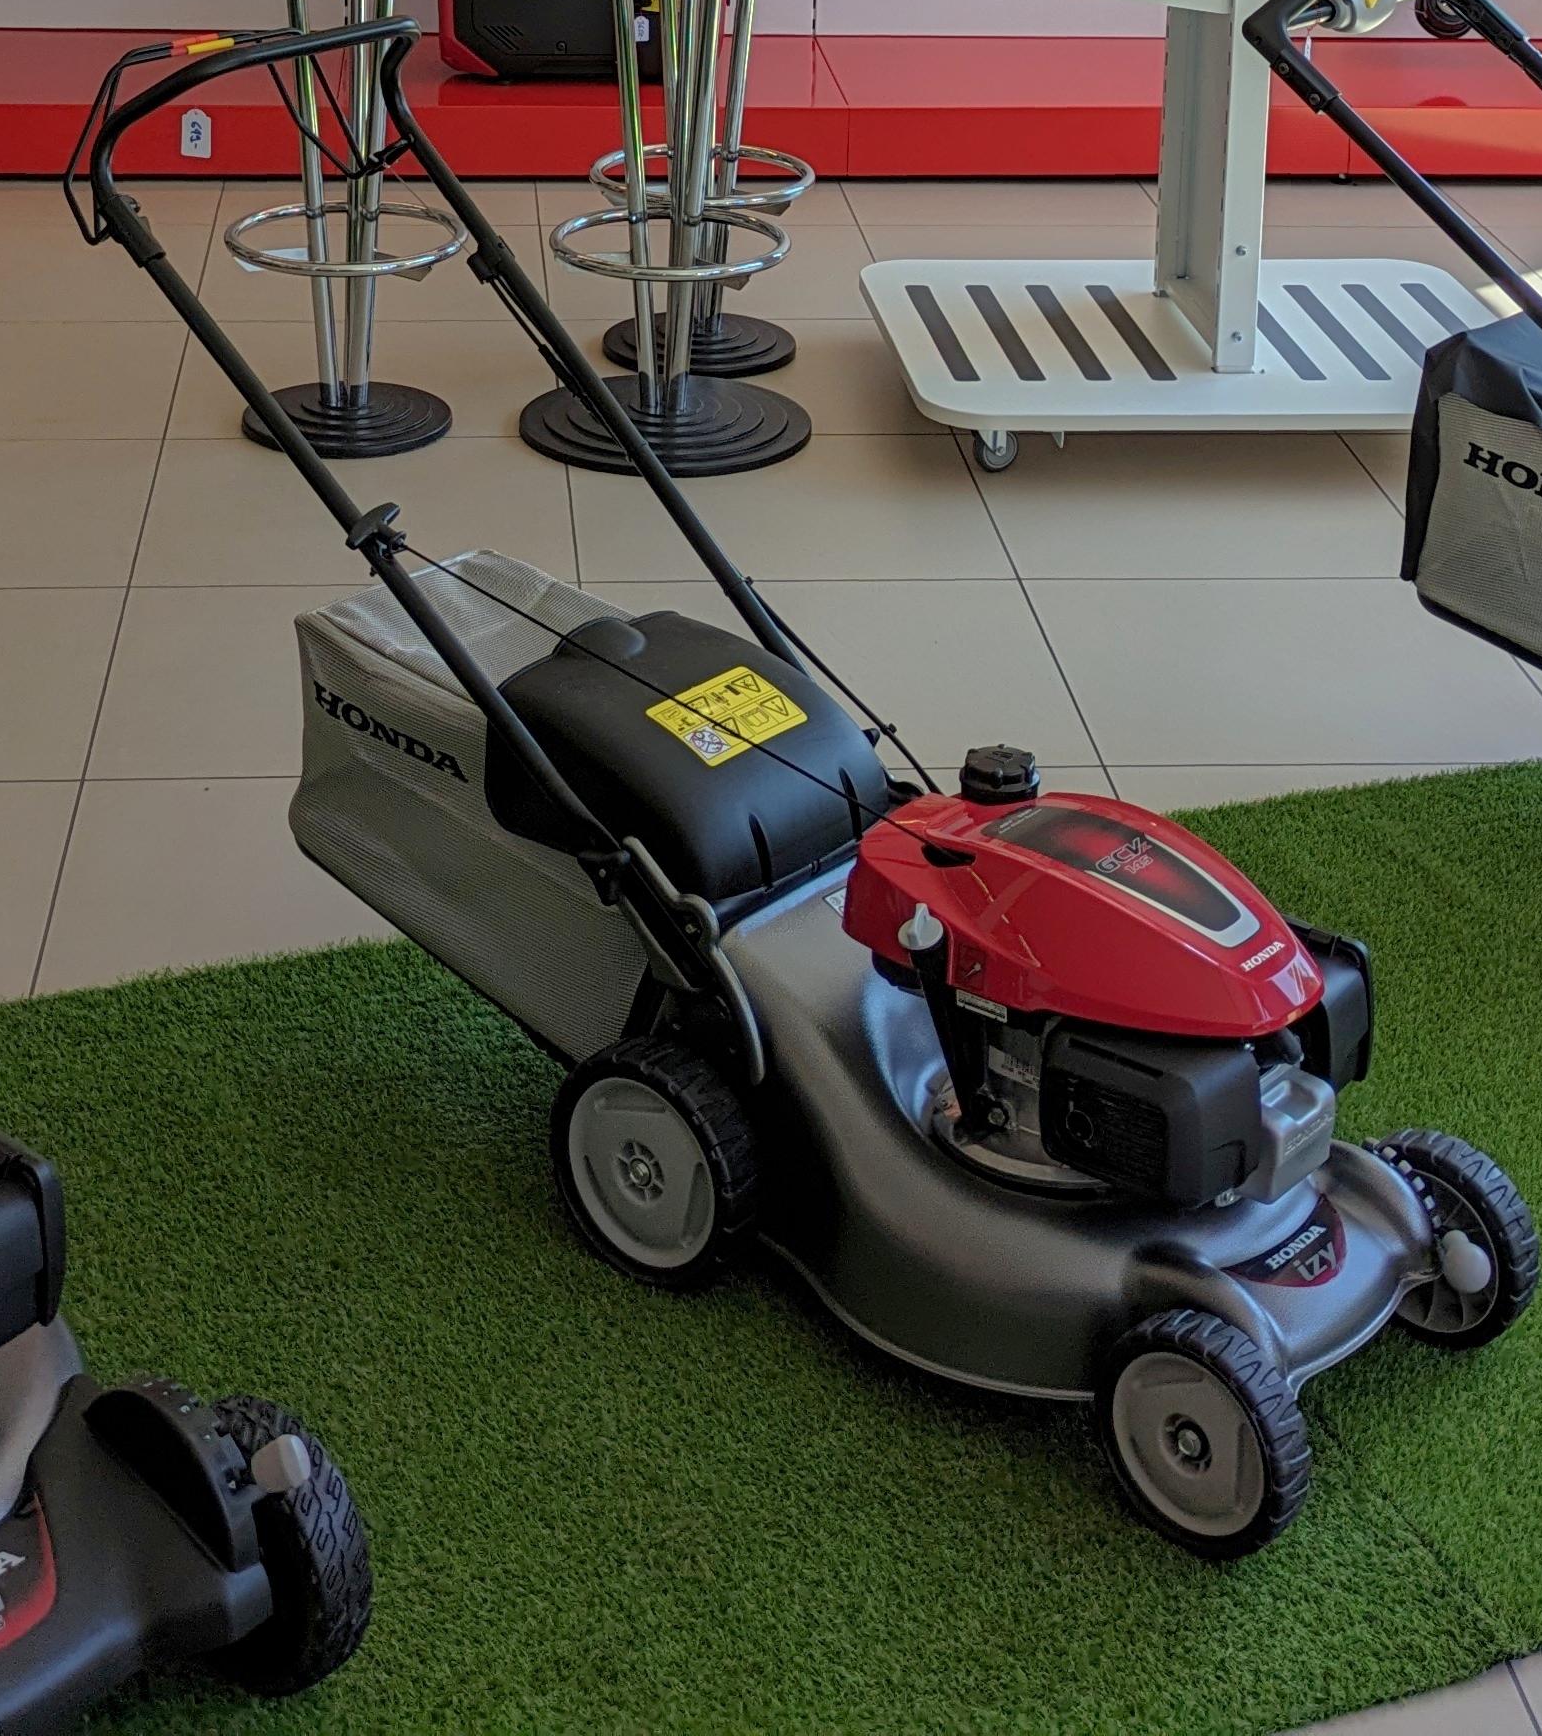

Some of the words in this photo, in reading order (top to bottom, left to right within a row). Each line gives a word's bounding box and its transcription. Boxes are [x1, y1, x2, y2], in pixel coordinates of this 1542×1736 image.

[313, 680, 469, 783] HONDA
[1239, 941, 1287, 973] HONDA
[1265, 1224, 1327, 1271] HONDA
[1292, 1240, 1337, 1282] izy
